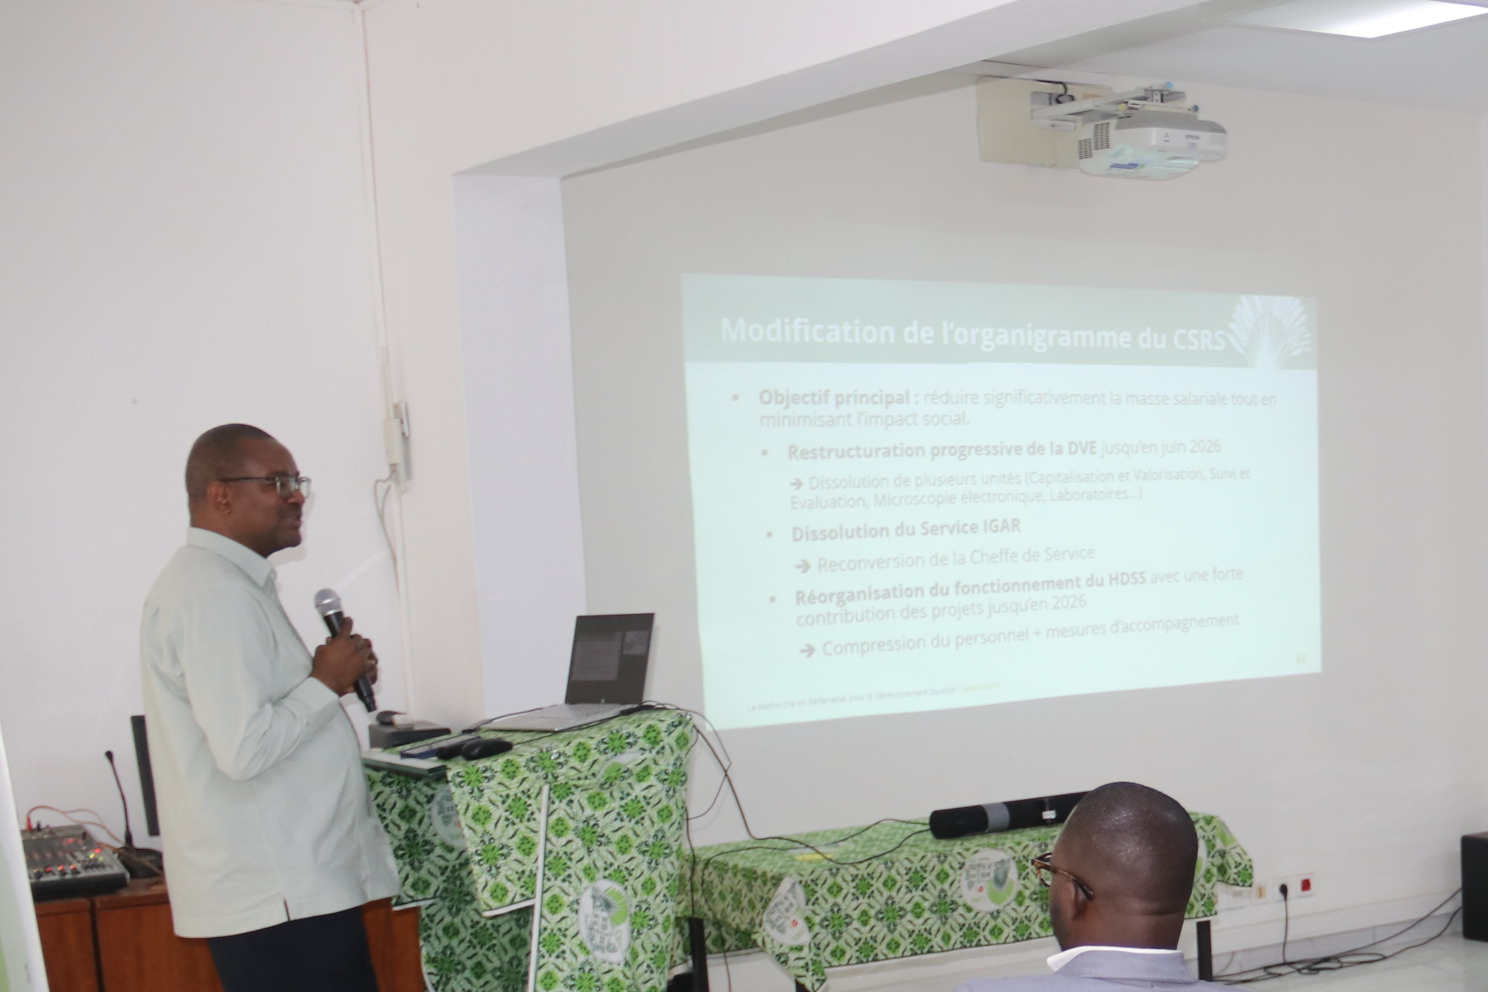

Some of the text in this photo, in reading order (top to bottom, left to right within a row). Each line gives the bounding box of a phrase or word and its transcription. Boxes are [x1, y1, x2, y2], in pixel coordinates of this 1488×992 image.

[721, 317, 896, 344] Modification
[903, 320, 934, 344] de
[1138, 327, 1166, 349] du
[1174, 329, 1226, 350] CSRS
[759, 388, 1277, 409] Objectif principal réduire significativement la masse salariale tout en
[760, 412, 852, 428] minimisant
[922, 410, 970, 427] social.
[788, 443, 925, 460] Restructuration
[931, 441, 1021, 461] progressive
[1027, 441, 1045, 456] de
[1050, 441, 1063, 456] la
[1068, 441, 1097, 455] DVE
[1161, 441, 1186, 458] juin
[1190, 439, 1222, 454] 2026
[808, 467, 1250, 490] Dissolution de plusieurs unités (Capitalisation et Valorisation, Suivi et
[790, 494, 869, 510] Evaluation,
[874, 492, 956, 508] Microscopie
[960, 489, 1046, 506] électronique,
[792, 518, 1021, 542] Dissolution du Service IGAR
[818, 546, 1095, 573] Reconversion de la Cheffe de Service
[795, 567, 1244, 606] Réorganisation du fonctionnement du HDSS avec une forte
[796, 606, 896, 628] contribution
[900, 604, 927, 620] des
[932, 602, 984, 622] projets
[1053, 594, 1087, 610] 2026
[822, 635, 926, 657] Compression
[931, 633, 950, 649] du
[955, 627, 1029, 651] personnel
[1046, 622, 1106, 639] mesures
